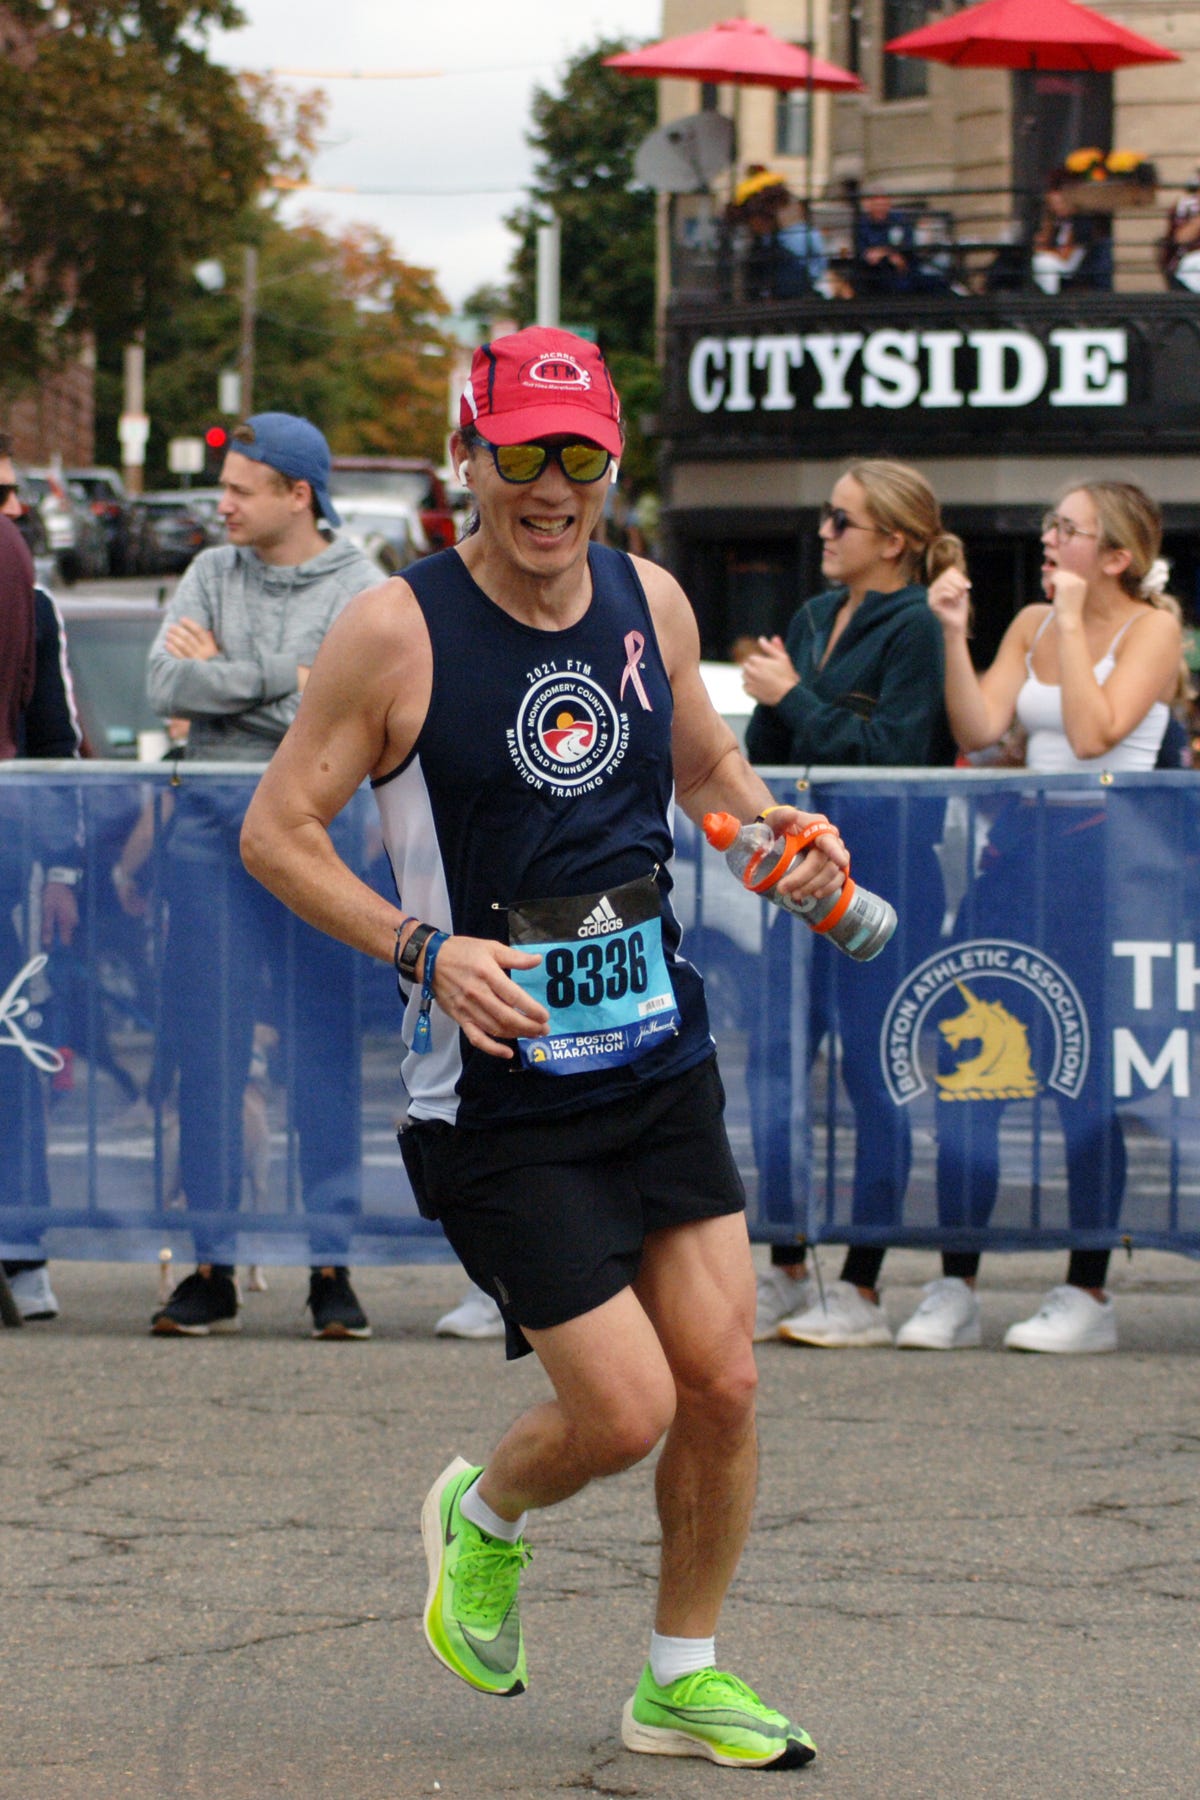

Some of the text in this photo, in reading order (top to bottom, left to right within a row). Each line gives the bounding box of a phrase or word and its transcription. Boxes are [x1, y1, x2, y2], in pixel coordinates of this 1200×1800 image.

[540, 363, 577, 380] FTM
[688, 328, 1128, 413] CITYSIDE
[526, 659, 592, 684] 2021 FTM
[527, 683, 607, 727] MONTGOMERY COUNTY
[505, 712, 630, 798] MARATHON TRAINING PROGRAM
[530, 733, 609, 775] ROAD RUNNERS CLUB
[577, 917, 624, 938] adidas
[545, 930, 648, 1009] 8336
[575, 1031, 623, 1047] BOSTON
[890, 949, 1083, 1093] BOSTON ATHLETIC ASSOCIATION
[552, 1042, 625, 1060] MARATHON
